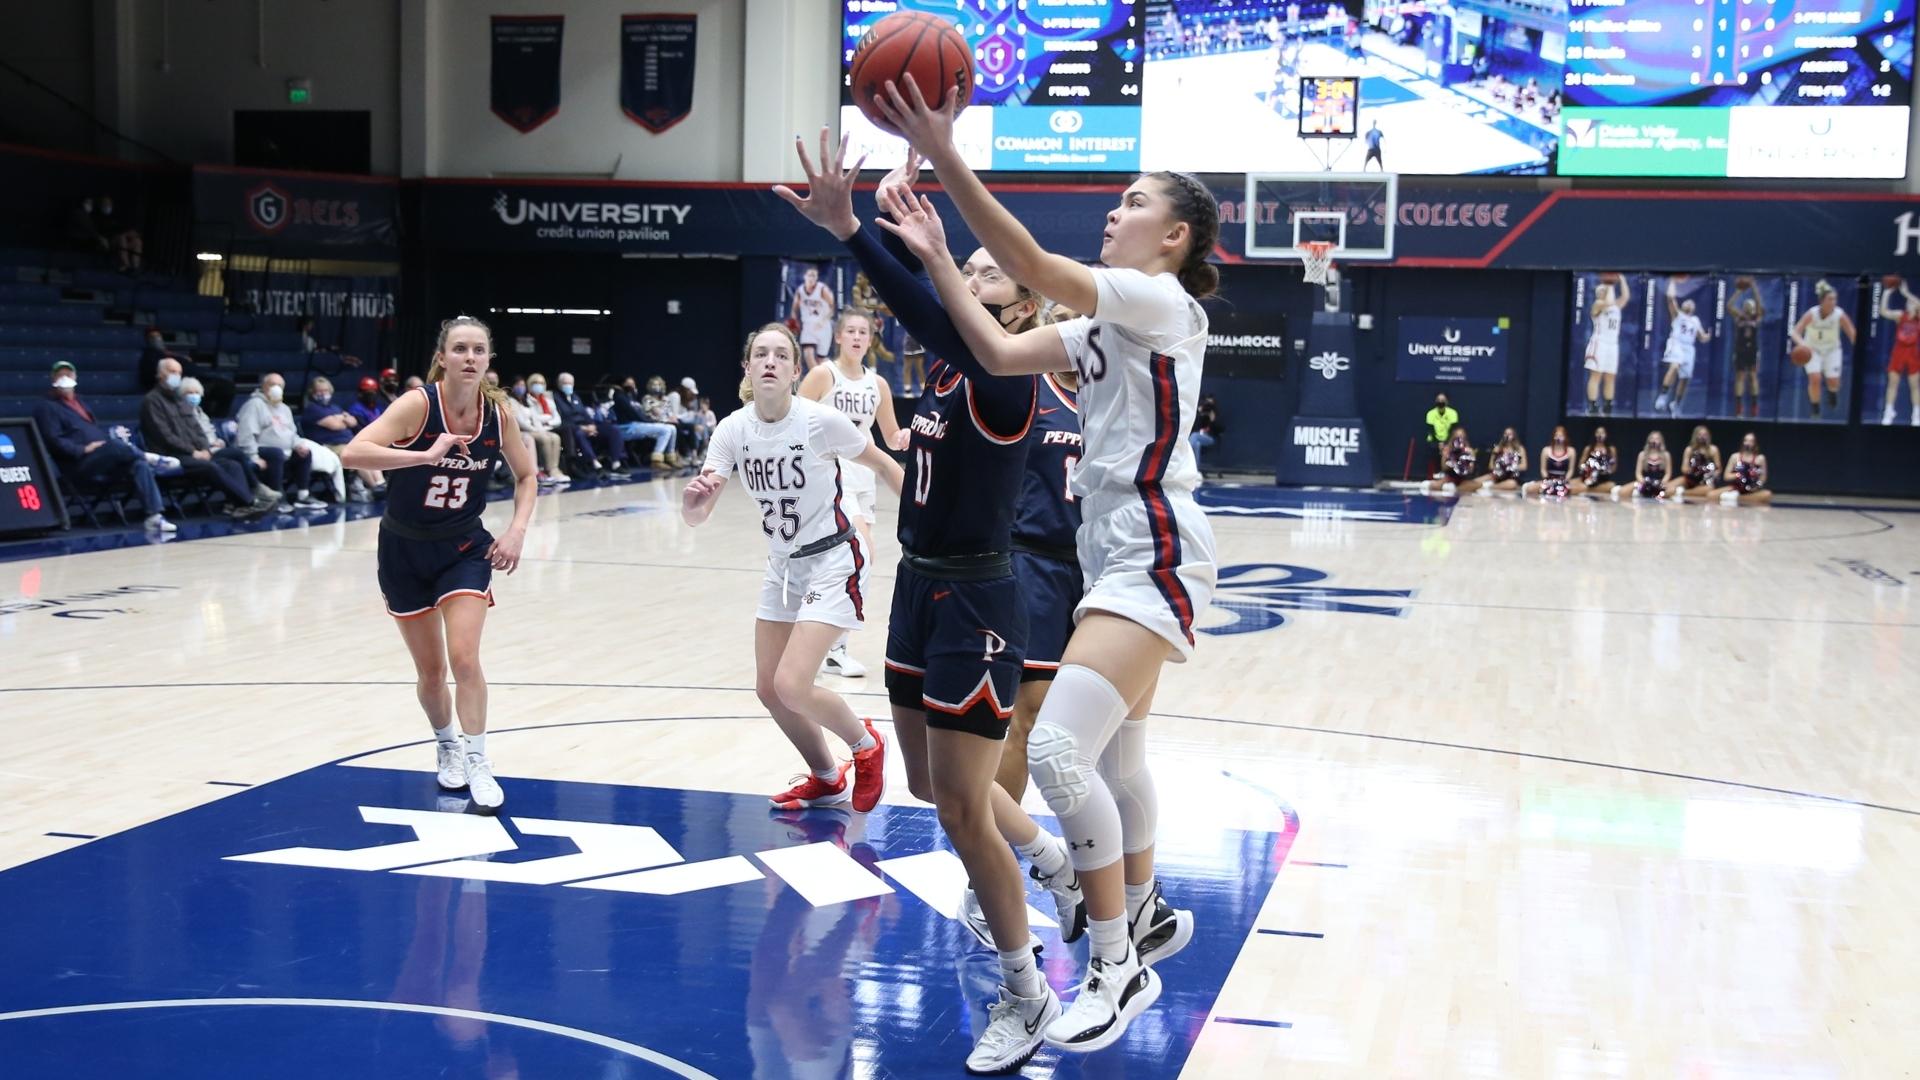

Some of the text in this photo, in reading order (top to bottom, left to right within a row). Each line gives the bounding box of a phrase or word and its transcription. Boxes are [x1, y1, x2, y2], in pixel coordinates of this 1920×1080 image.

[994, 136, 1136, 151] COMMON INTEREST
[496, 195, 692, 225] UNIVERSITY
[1219, 201, 1279, 224] AINT
[1399, 202, 1509, 228] COLLEGE
[537, 226, 670, 242] credit union pavilion
[1207, 335, 1281, 348] SHAMROCK
[1408, 342, 1496, 357] UNIVERSITY
[834, 390, 876, 415] GAELS
[1042, 430, 1083, 447] PEPP
[1294, 426, 1360, 448] MUSCLE
[1304, 446, 1350, 466] MILK
[0, 466, 32, 483] GUEST
[744, 455, 806, 492] GAELS
[424, 475, 470, 509] 23
[756, 497, 800, 543] 25
